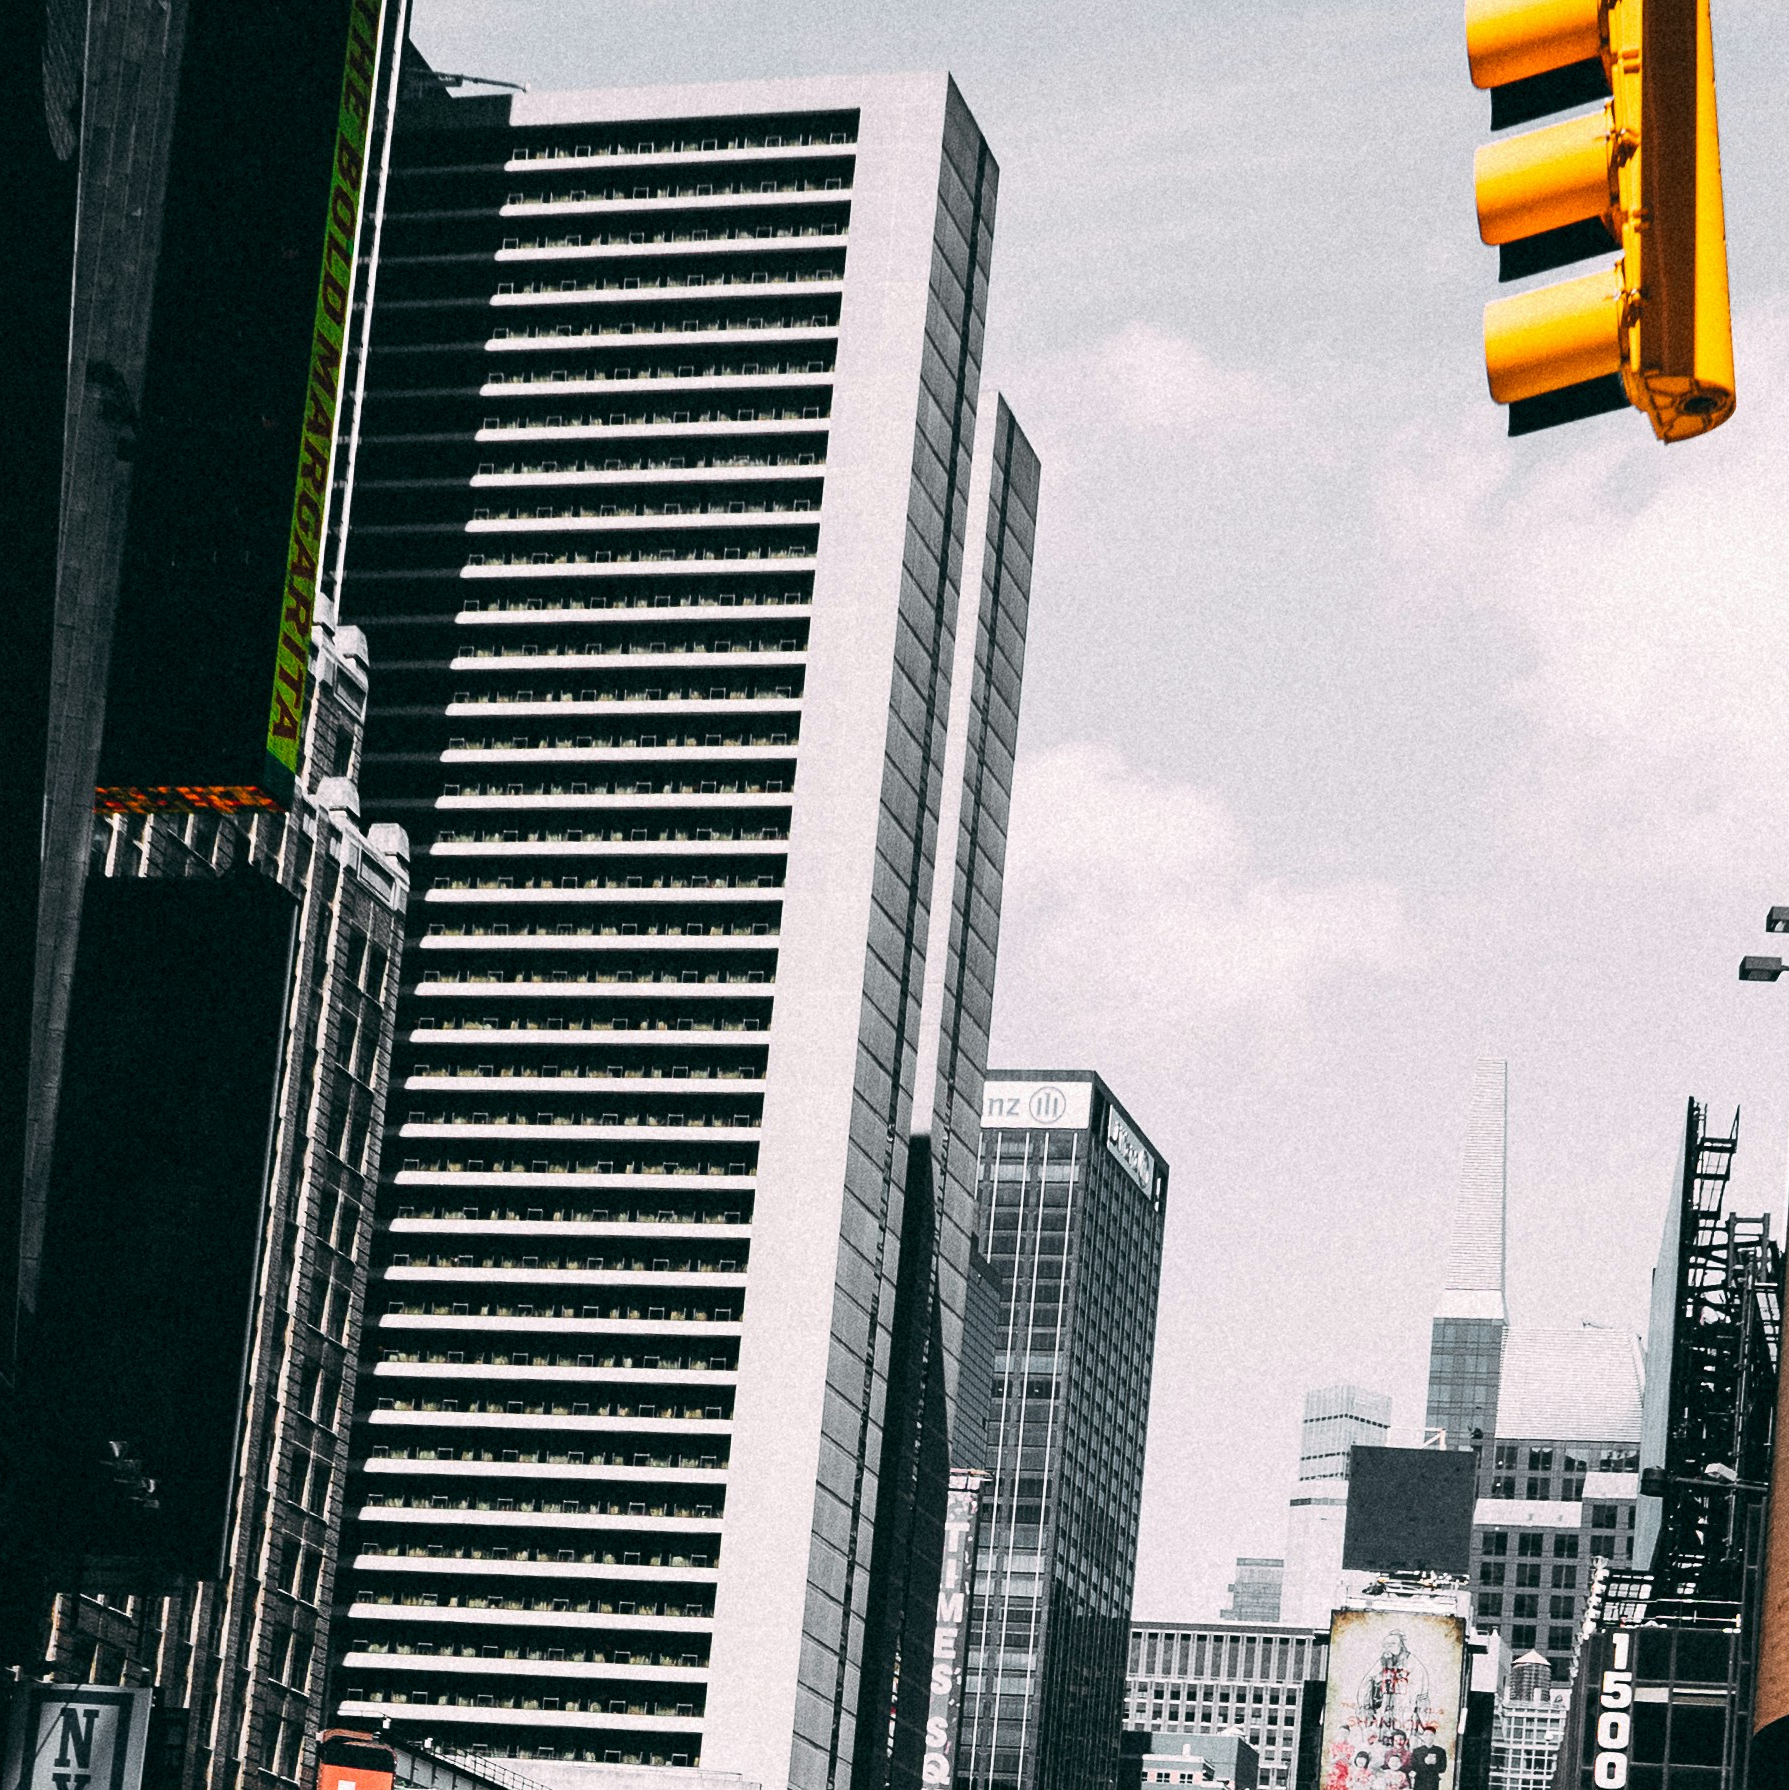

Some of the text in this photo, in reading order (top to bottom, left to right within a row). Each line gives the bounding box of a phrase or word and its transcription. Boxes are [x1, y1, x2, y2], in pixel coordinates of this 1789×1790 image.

[321, 137, 368, 325] BOLD
[270, 328, 348, 740] MARGARITA
[930, 1521, 968, 1698] TIMES
[1594, 1632, 1633, 1790] 1500
